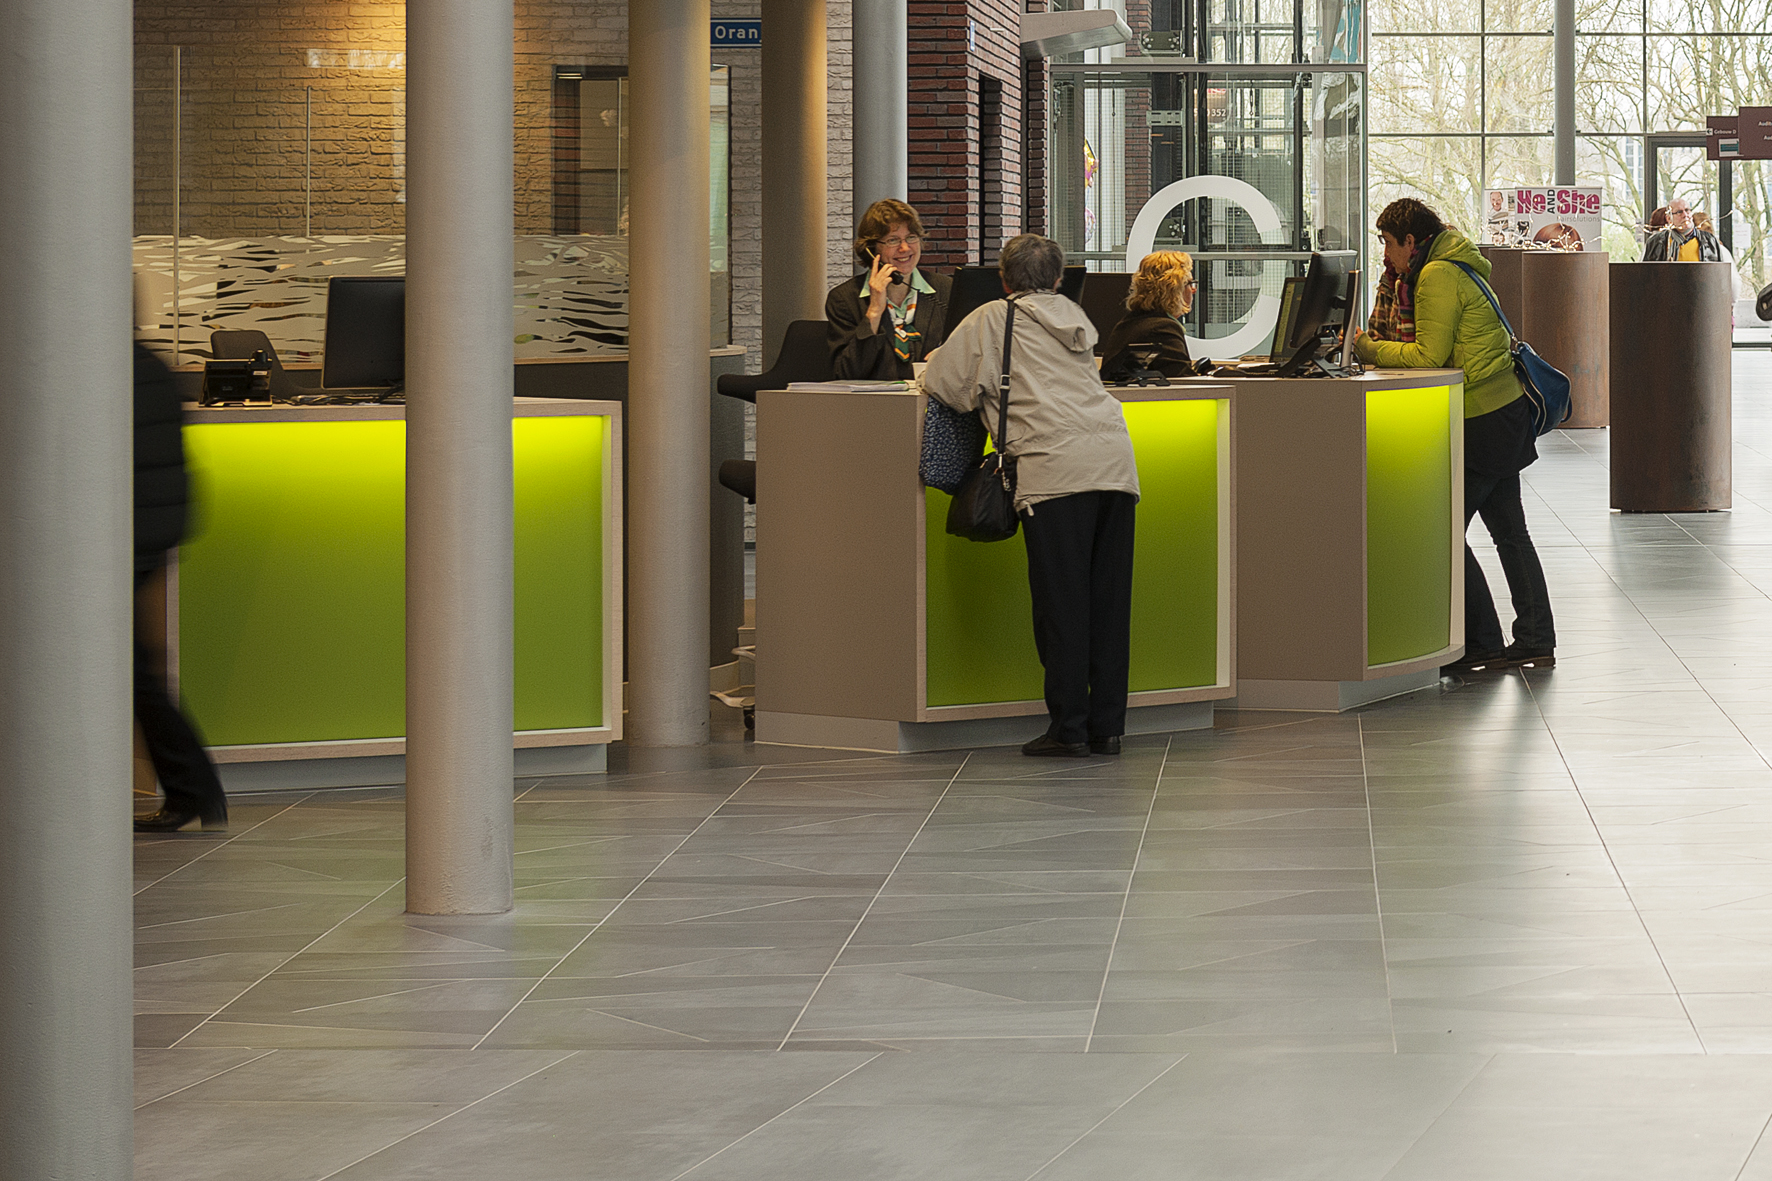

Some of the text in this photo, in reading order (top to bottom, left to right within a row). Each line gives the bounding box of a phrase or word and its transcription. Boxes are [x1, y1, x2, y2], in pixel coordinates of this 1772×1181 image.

[715, 25, 762, 43] Oran
[1517, 189, 1600, 214] He AND She
